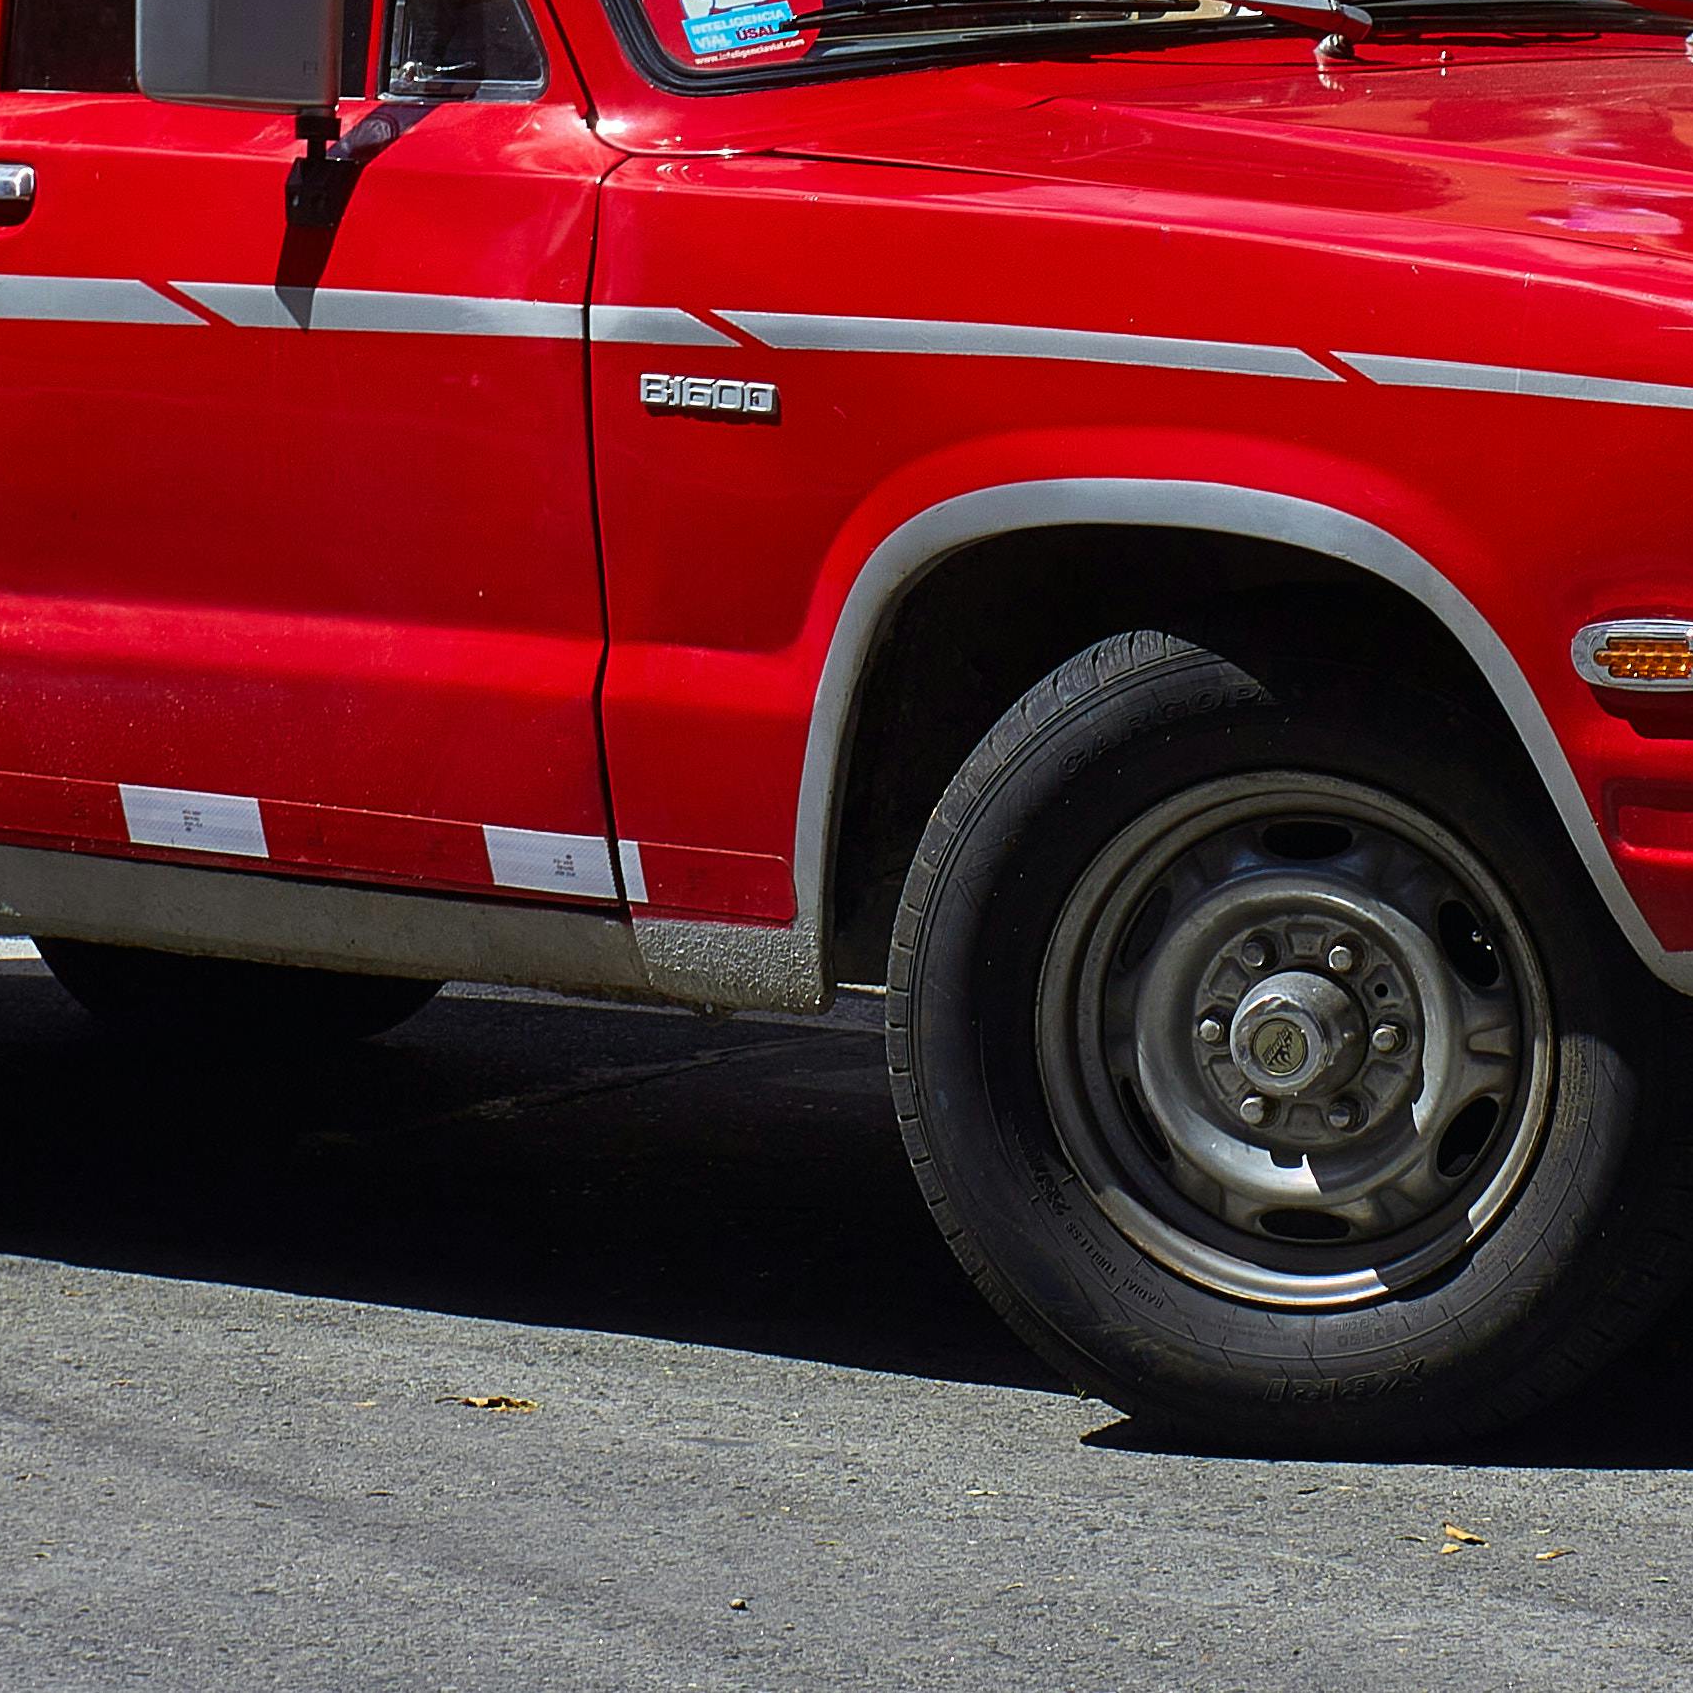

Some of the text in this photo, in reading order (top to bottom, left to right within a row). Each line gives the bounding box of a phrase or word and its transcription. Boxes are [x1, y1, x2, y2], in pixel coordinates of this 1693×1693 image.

[690, 8, 786, 35] INTELIGENCIA
[694, 23, 781, 51] VIAL ÚSAL
[640, 373, 775, 413] B1600
